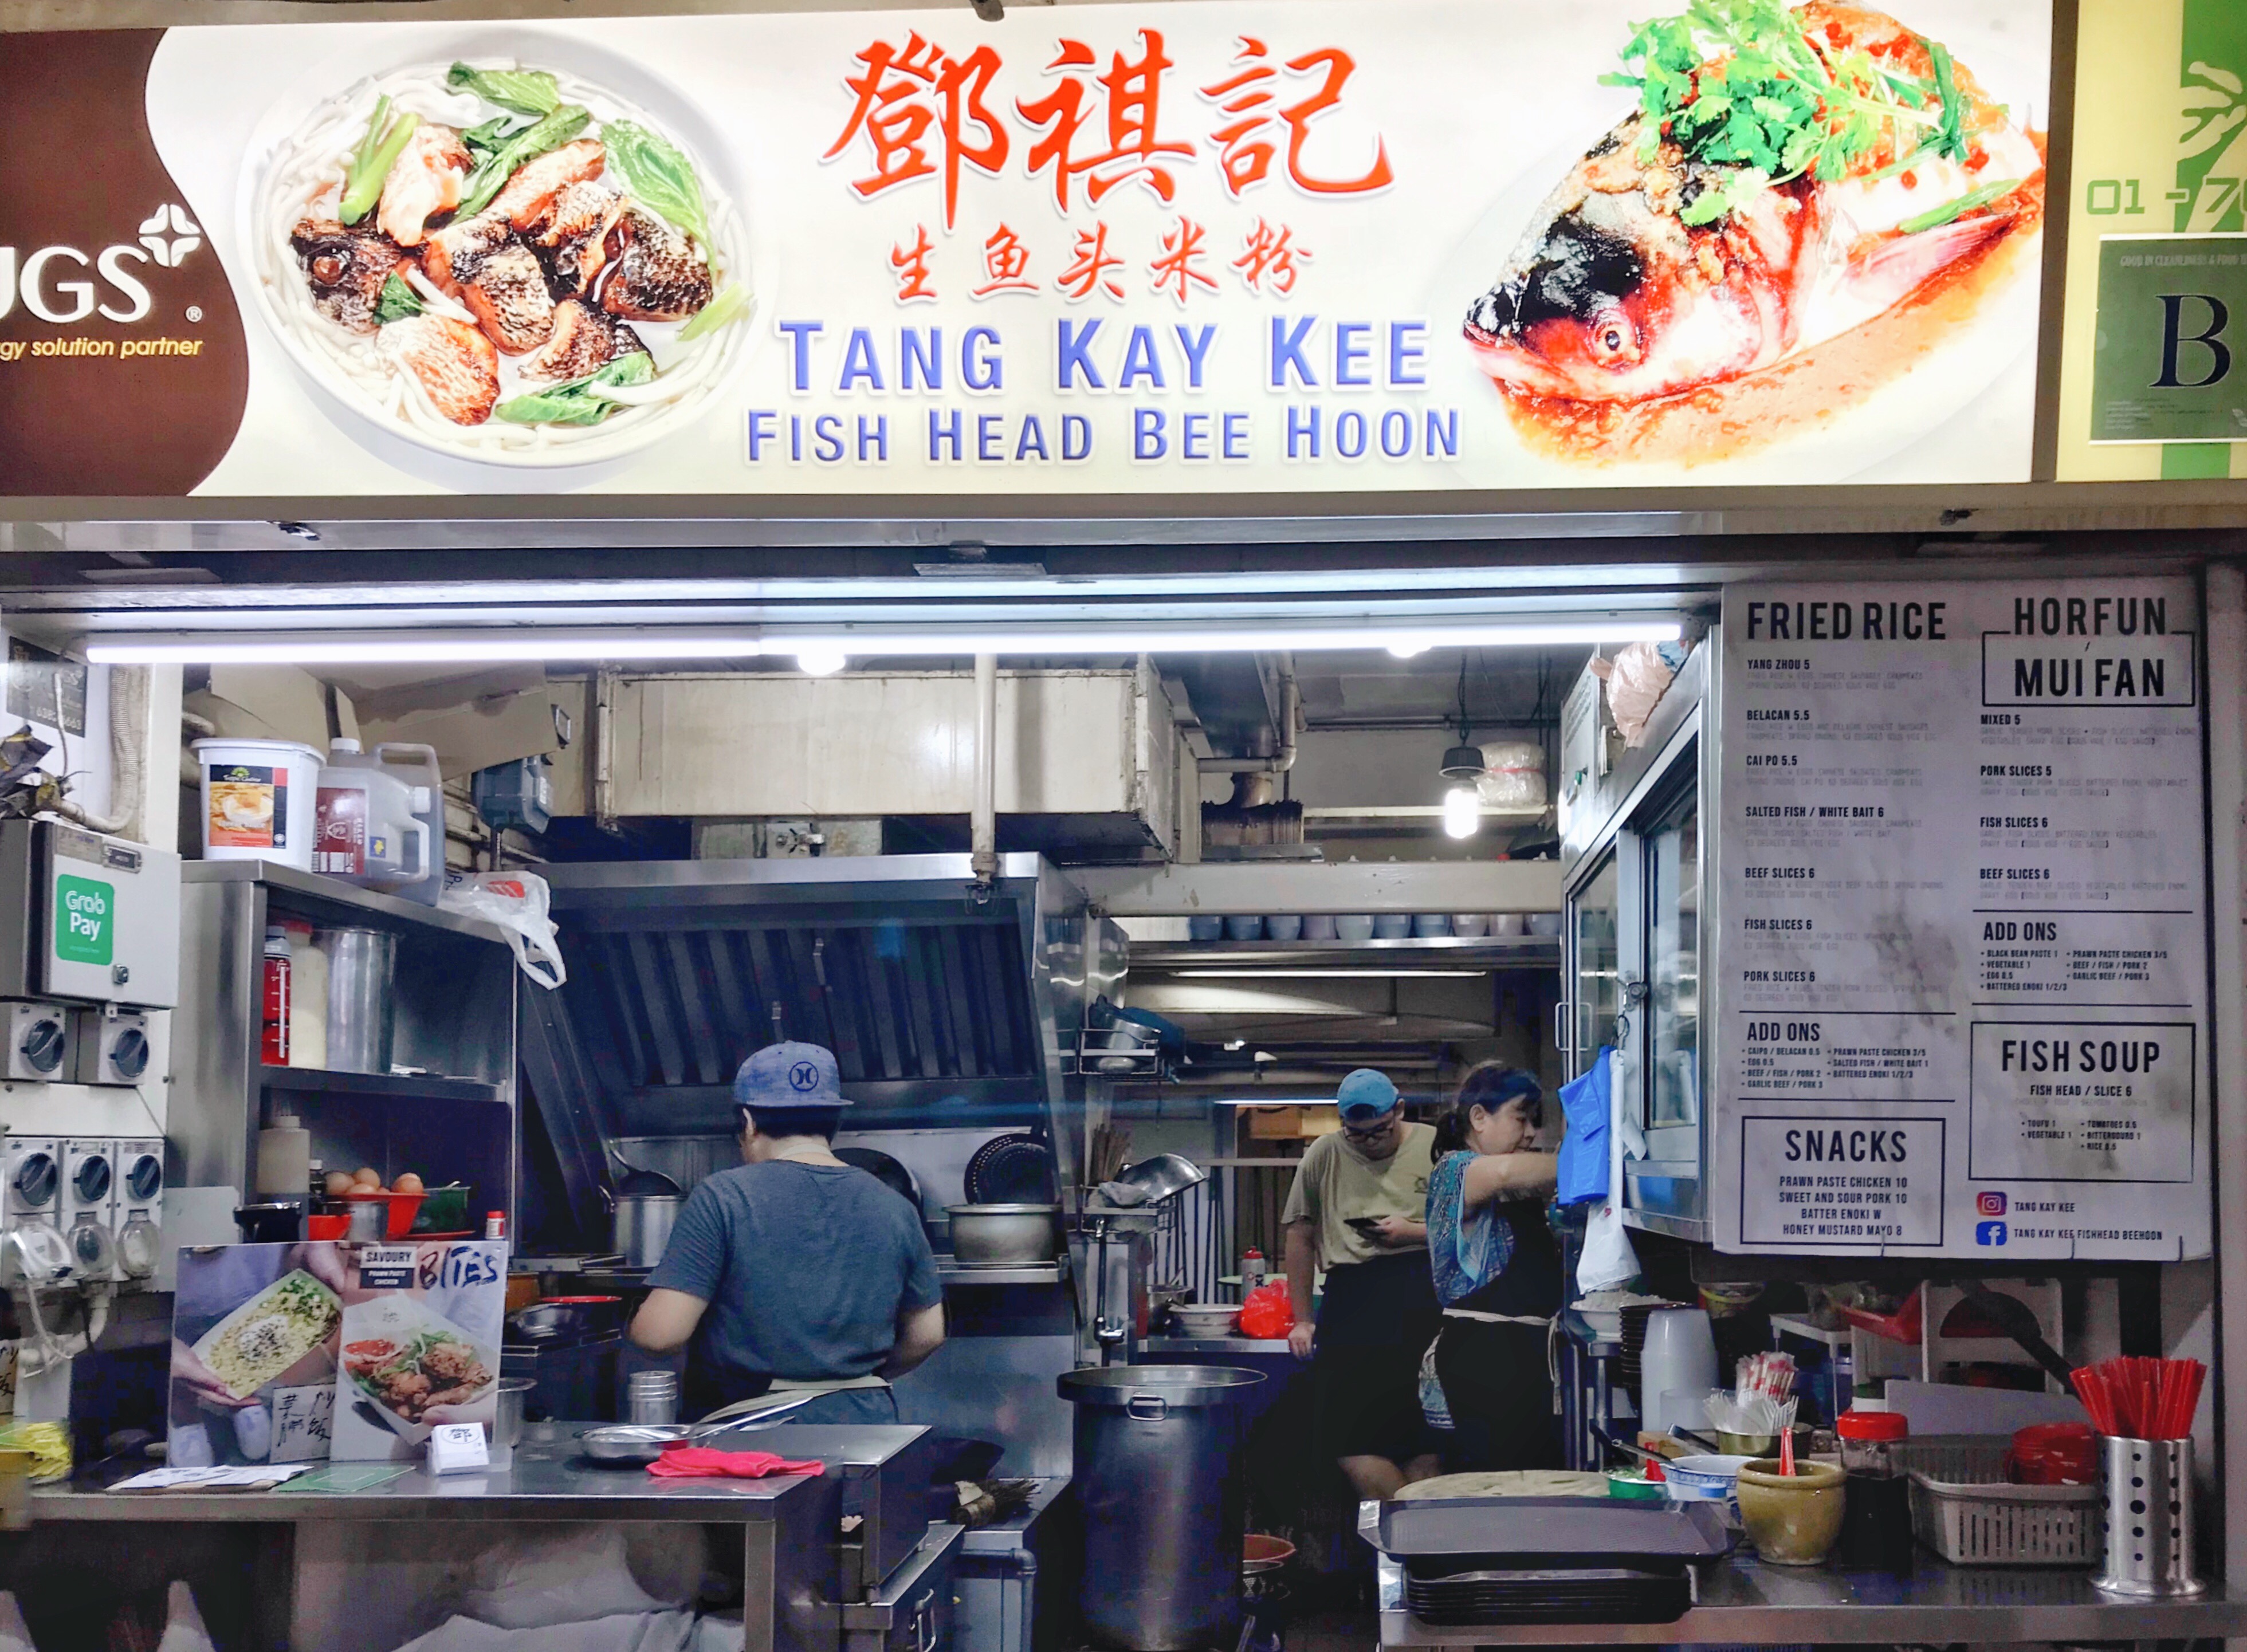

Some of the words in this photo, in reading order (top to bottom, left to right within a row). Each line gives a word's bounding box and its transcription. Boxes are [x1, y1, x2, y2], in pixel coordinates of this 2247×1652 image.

[824, 27, 1394, 230] 鄧祺記
[890, 217, 1312, 302] 生鱼头米粉
[0, 245, 151, 323] GS
[2148, 293, 2231, 388] B
[30, 337, 115, 356] solution
[119, 337, 203, 359] partner
[779, 321, 1003, 390] TANG
[1058, 318, 1216, 388] KAY
[1271, 315, 1426, 386] KEE
[748, 410, 887, 460] FISH
[929, 408, 1093, 459] HEAD
[1134, 407, 1248, 459] BEE
[1287, 405, 1459, 457] HOON
[1747, 601, 1852, 640] FRIED
[1863, 601, 1946, 640] RICE
[2014, 596, 2166, 636] HORFUN
[1747, 659, 1773, 670] YANG
[1775, 659, 1801, 670] ZHOU
[1804, 659, 1810, 670] 5
[2014, 658, 2083, 697] MUI
[2095, 658, 2164, 697] FAN
[1746, 709, 1790, 721] BELACAN
[1793, 709, 1810, 721] 5.5
[1980, 714, 2012, 725] MIXED
[2014, 714, 2021, 726] 5
[1746, 754, 1762, 766] CAI
[1765, 754, 1778, 766] PO
[1781, 754, 1798, 766] 5.5
[1980, 765, 2006, 776] PORK
[2009, 765, 2042, 777] SLICES
[2045, 765, 2052, 777] 5
[1745, 806, 1781, 817] SALTED
[1784, 806, 1806, 817] FISH
[1818, 806, 1849, 817] WHITE
[1852, 807, 1875, 818] BAIT
[1877, 807, 1884, 818] 6
[1979, 816, 2002, 828] FISH
[2005, 816, 2038, 828] SLICES
[2041, 817, 2048, 828] 6
[1745, 867, 1769, 879] BEEF
[1771, 867, 1805, 879] SLICES
[1808, 867, 1815, 879] 6
[1979, 868, 2004, 879] BEEF
[2006, 868, 2040, 880] SLICES
[2043, 868, 2050, 880] 6
[65, 891, 105, 915] Grab
[70, 912, 101, 941] Pay
[1744, 918, 1766, 930] FISH
[1769, 919, 1803, 931] SLICES
[1805, 919, 1812, 930] 6
[1983, 921, 2017, 941] ADD
[2023, 922, 2057, 941] ONS
[1743, 970, 1769, 982] PORK
[1772, 970, 1806, 982] SLICES
[1808, 970, 1816, 982] 6
[1747, 1022, 1781, 1041] ADD
[1787, 1022, 1820, 1042] ONS
[2002, 1040, 2069, 1072] FISH
[2079, 1040, 2160, 1073] SOUP
[2030, 1084, 2052, 1096] FISH
[2055, 1085, 2081, 1096] HEAD
[2093, 1085, 2122, 1097] SLICE
[2125, 1085, 2132, 1098] 6
[1785, 1129, 1907, 1163] SNACKS
[1779, 1175, 1813, 1187] PRAWN
[1817, 1176, 1847, 1187] PASTE
[1849, 1176, 1892, 1188] CHICKEN
[1895, 1177, 1908, 1189] 10
[1778, 1191, 1812, 1203] SWEET
[1814, 1192, 1834, 1203] AND
[1837, 1192, 1863, 1203] SOUR
[1865, 1192, 1892, 1204] PORK
[1895, 1193, 1907, 1204] 10
[1801, 1207, 1837, 1220] BATTER
[1840, 1208, 1869, 1220] ENOKI
[1873, 1209, 1881, 1220] W
[2014, 1201, 2036, 1212] TANG
[2039, 1202, 2056, 1212] KAY
[2058, 1202, 2075, 1213] KEE
[1782, 1224, 1814, 1235] HONEY
[1818, 1224, 1863, 1236] MUSTARD
[1896, 1225, 1902, 1236] 8
[2014, 1228, 2036, 1238] TANG
[2038, 1229, 2054, 1238] KAY
[2058, 1229, 2075, 1239] KEE
[2077, 1229, 2120, 1240] FISHHEAD
[2122, 1230, 2163, 1241] BEEHOON
[366, 1252, 412, 1262] SAVOURY
